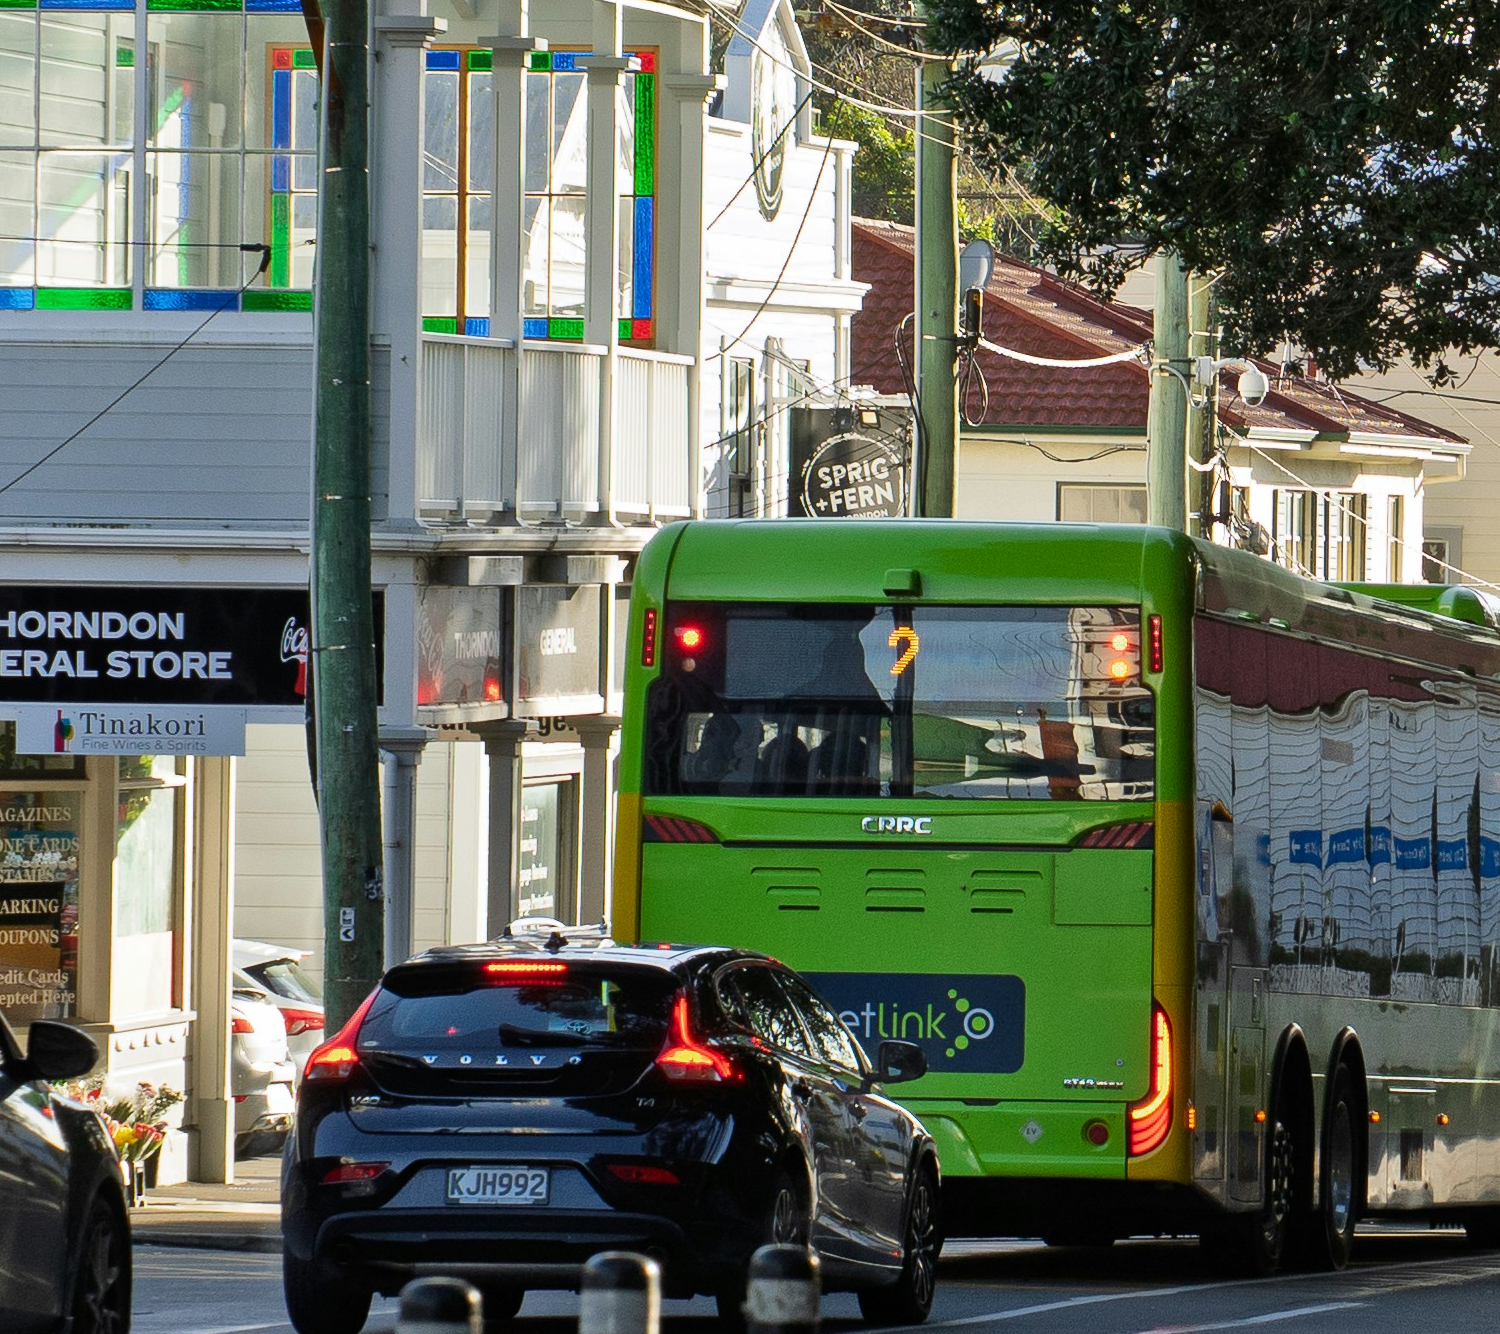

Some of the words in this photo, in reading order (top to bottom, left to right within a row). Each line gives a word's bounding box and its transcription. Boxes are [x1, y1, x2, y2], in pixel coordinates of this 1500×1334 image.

[817, 457, 890, 489] SPRIG
[454, 631, 500, 659] THORNDON
[540, 627, 578, 656] GENERAL
[106, 650, 233, 680] STORE
[79, 712, 206, 736] Tinakori
[81, 739, 109, 750] Fine
[113, 739, 151, 751] Wines
[154, 740, 163, 750] &
[166, 740, 207, 753] Spirits
[861, 816, 933, 835] CRRC
[28, 837, 80, 852] CARDS
[27, 969, 69, 984] Cards
[41, 989, 76, 1004] Here
[835, 1002, 947, 1039] etlink
[422, 1054, 582, 1065] VOLVO
[350, 1095, 380, 1106] V40
[636, 1097, 655, 1108] T4
[1025, 1126, 1038, 1137] EV
[450, 1172, 546, 1197] KJH992
